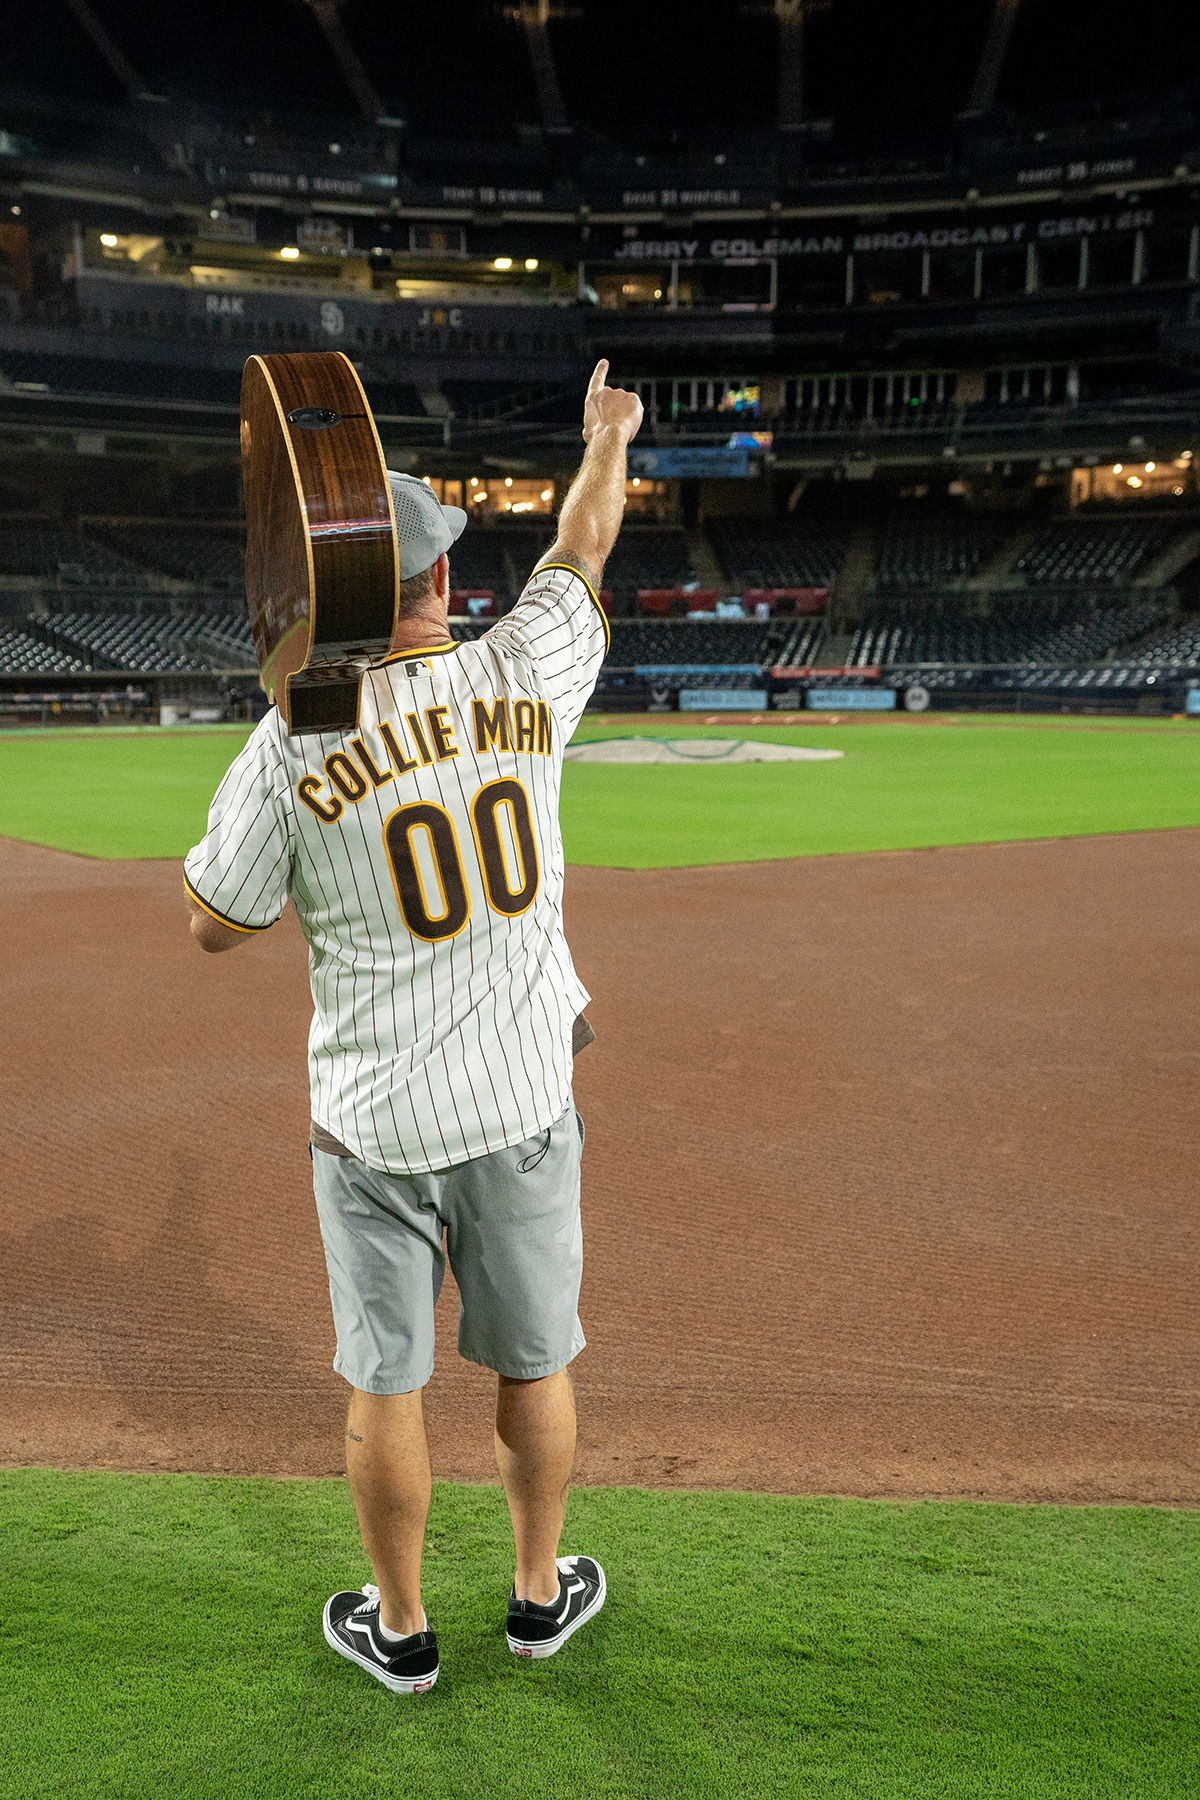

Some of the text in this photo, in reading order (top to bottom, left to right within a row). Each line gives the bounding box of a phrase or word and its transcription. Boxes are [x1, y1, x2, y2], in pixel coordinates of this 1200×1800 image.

[614, 240, 699, 258] JERRY
[709, 236, 843, 257] COLEMAN
[852, 222, 1027, 252] BROADCAST
[206, 294, 244, 317] RAK
[297, 698, 552, 824] COLLIE MAN
[382, 776, 540, 943] 00
